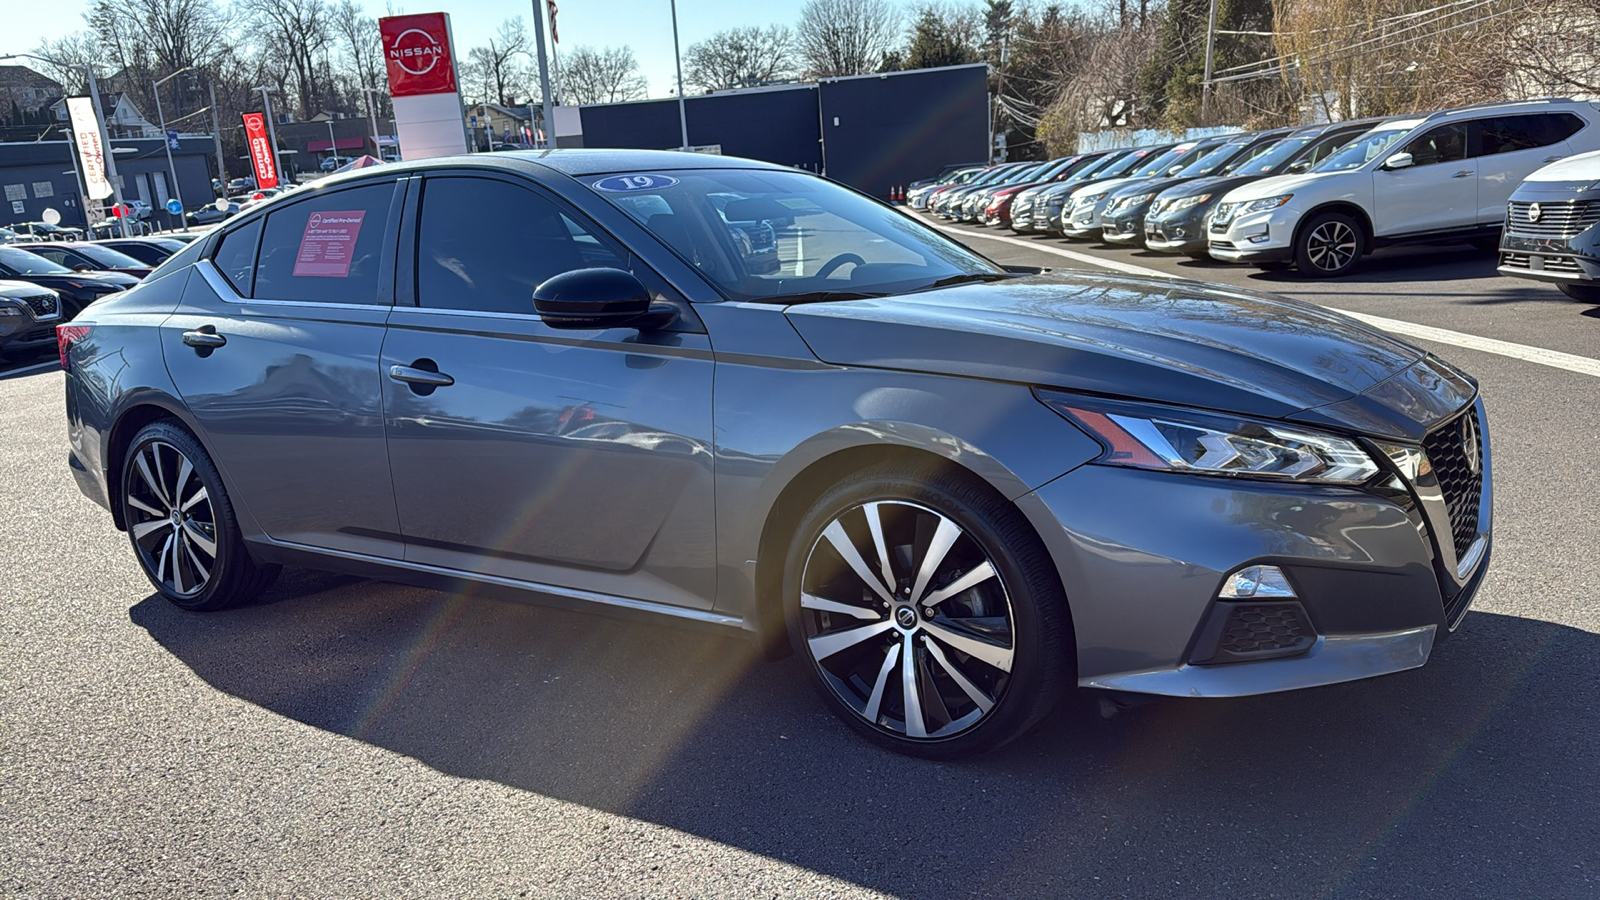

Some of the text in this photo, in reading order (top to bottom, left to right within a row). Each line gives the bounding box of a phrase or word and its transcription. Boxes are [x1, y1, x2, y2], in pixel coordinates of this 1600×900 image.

[389, 46, 442, 58] NISSAN
[80, 132, 98, 184] CERTIFIED
[252, 138, 268, 180] CERTIFIED
[258, 137, 274, 179] Pre-Owned
[618, 175, 653, 189] 19
